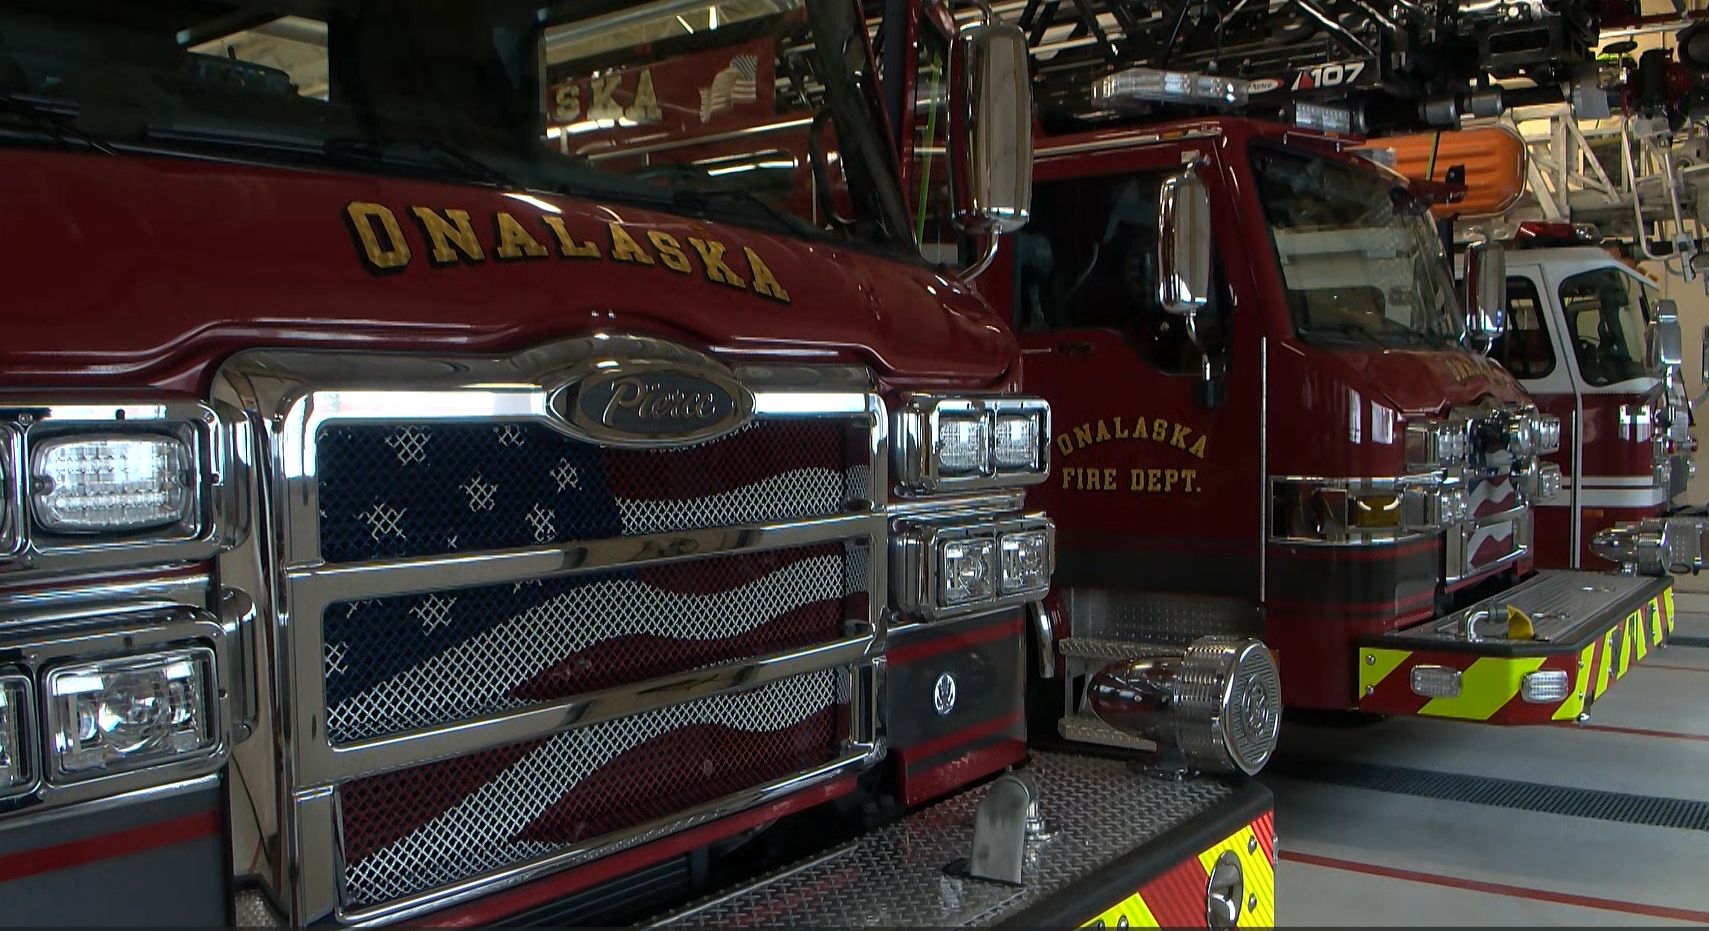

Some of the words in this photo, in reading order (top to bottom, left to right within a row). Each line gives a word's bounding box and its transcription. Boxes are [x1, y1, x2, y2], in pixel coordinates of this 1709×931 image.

[1311, 63, 1365, 89] 107
[346, 201, 790, 302] ONALASKA
[602, 377, 716, 427] Pierce
[1056, 416, 1206, 459] ONALASKA
[1062, 467, 1117, 490] FIRE
[1131, 469, 1201, 492] DEPT.
